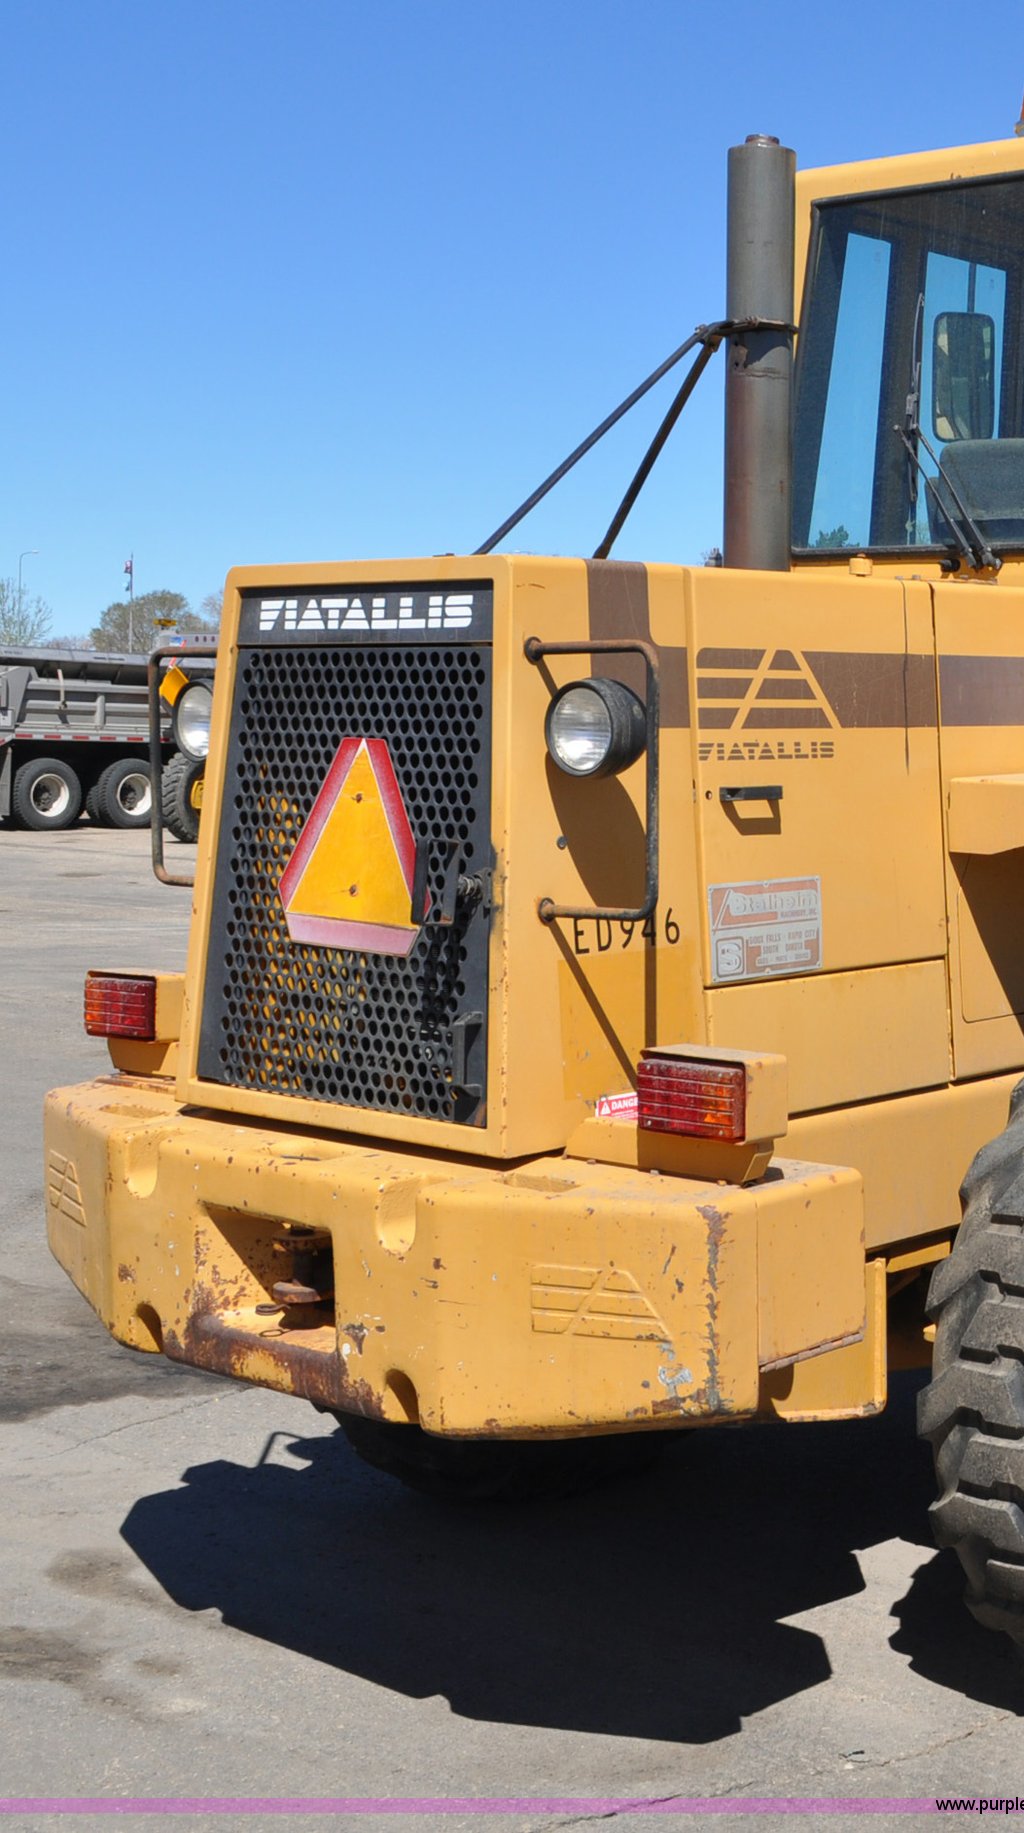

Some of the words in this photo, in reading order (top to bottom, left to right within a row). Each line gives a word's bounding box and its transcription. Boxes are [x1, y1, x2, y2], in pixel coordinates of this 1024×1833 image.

[259, 595, 474, 631] FIATALLIS
[698, 741, 835, 761] FIATALLIS
[573, 907, 681, 955] ED946
[804, 929, 816, 938] CITY
[611, 1097, 639, 1111] DANGE
